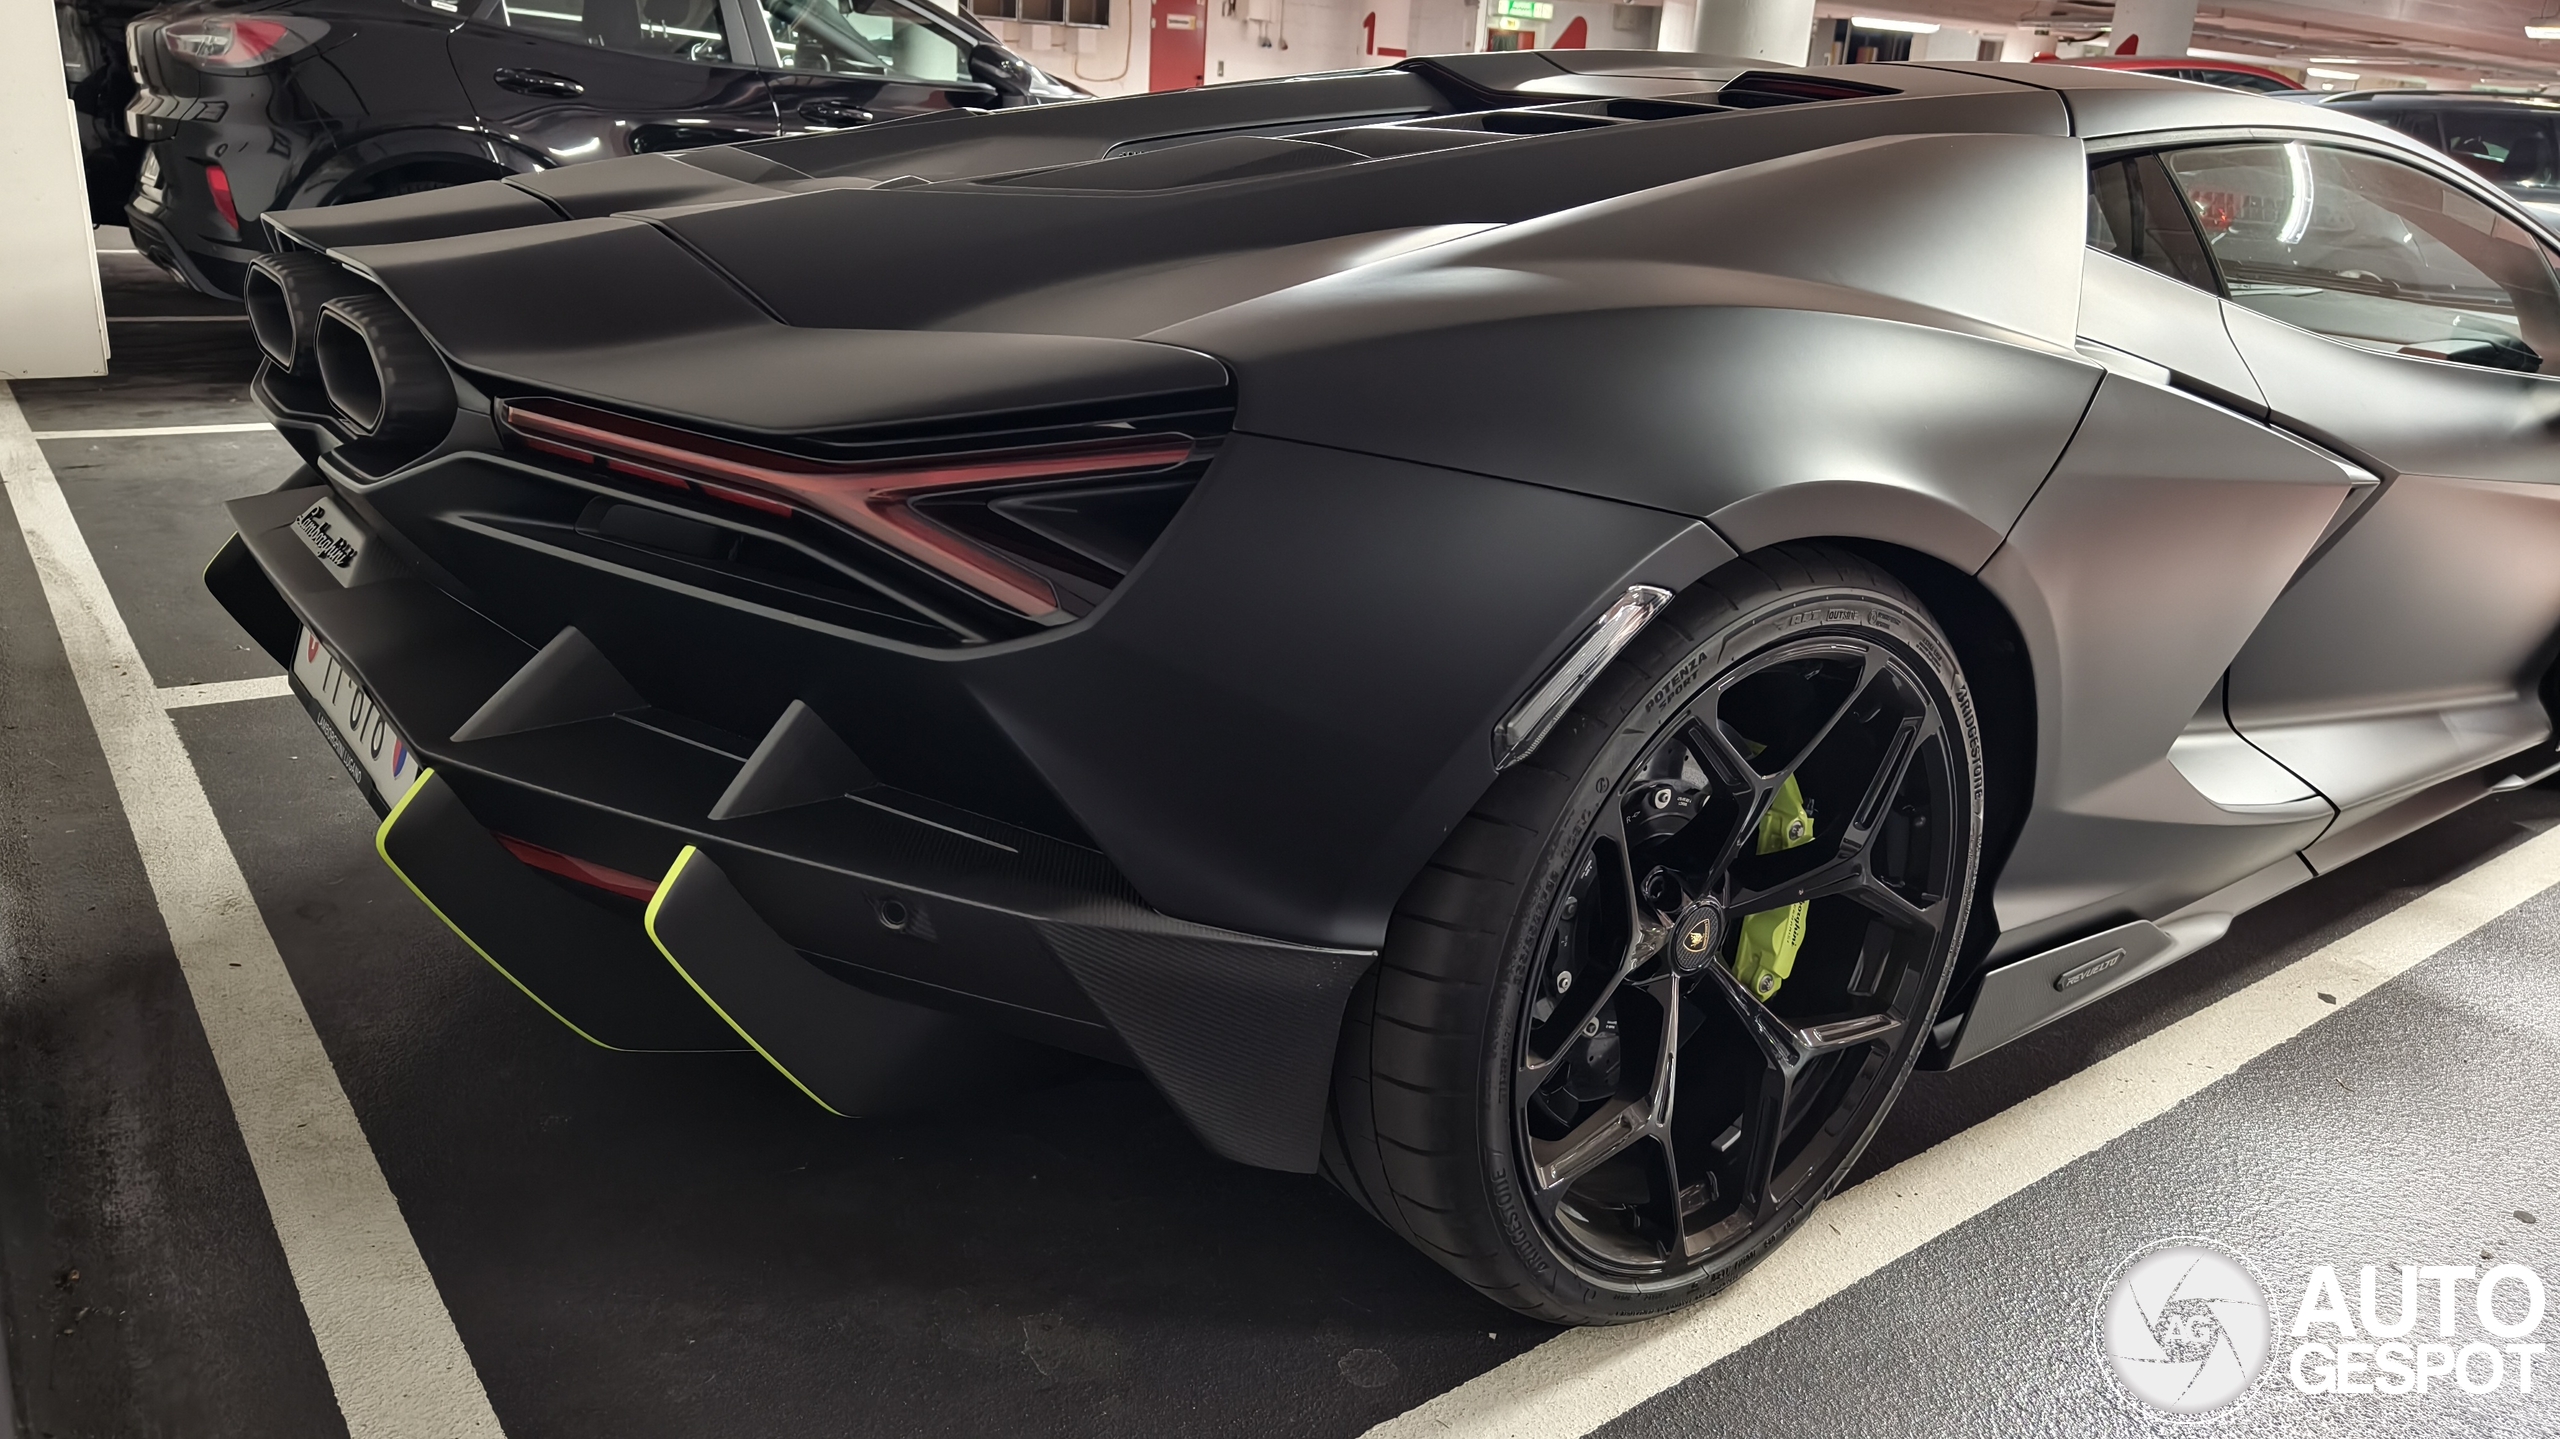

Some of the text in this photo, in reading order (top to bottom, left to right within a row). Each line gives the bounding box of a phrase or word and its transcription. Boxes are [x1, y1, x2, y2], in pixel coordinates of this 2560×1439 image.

[296, 506, 347, 567] Lamborghini
[1645, 651, 1708, 714] POTENZA
[1658, 669, 1699, 713] SPORT
[1955, 685, 1983, 800] BRIDGESTONE
[2065, 954, 2120, 988] REVUELTO
[1490, 1167, 1550, 1280] BRIDGESTONE
